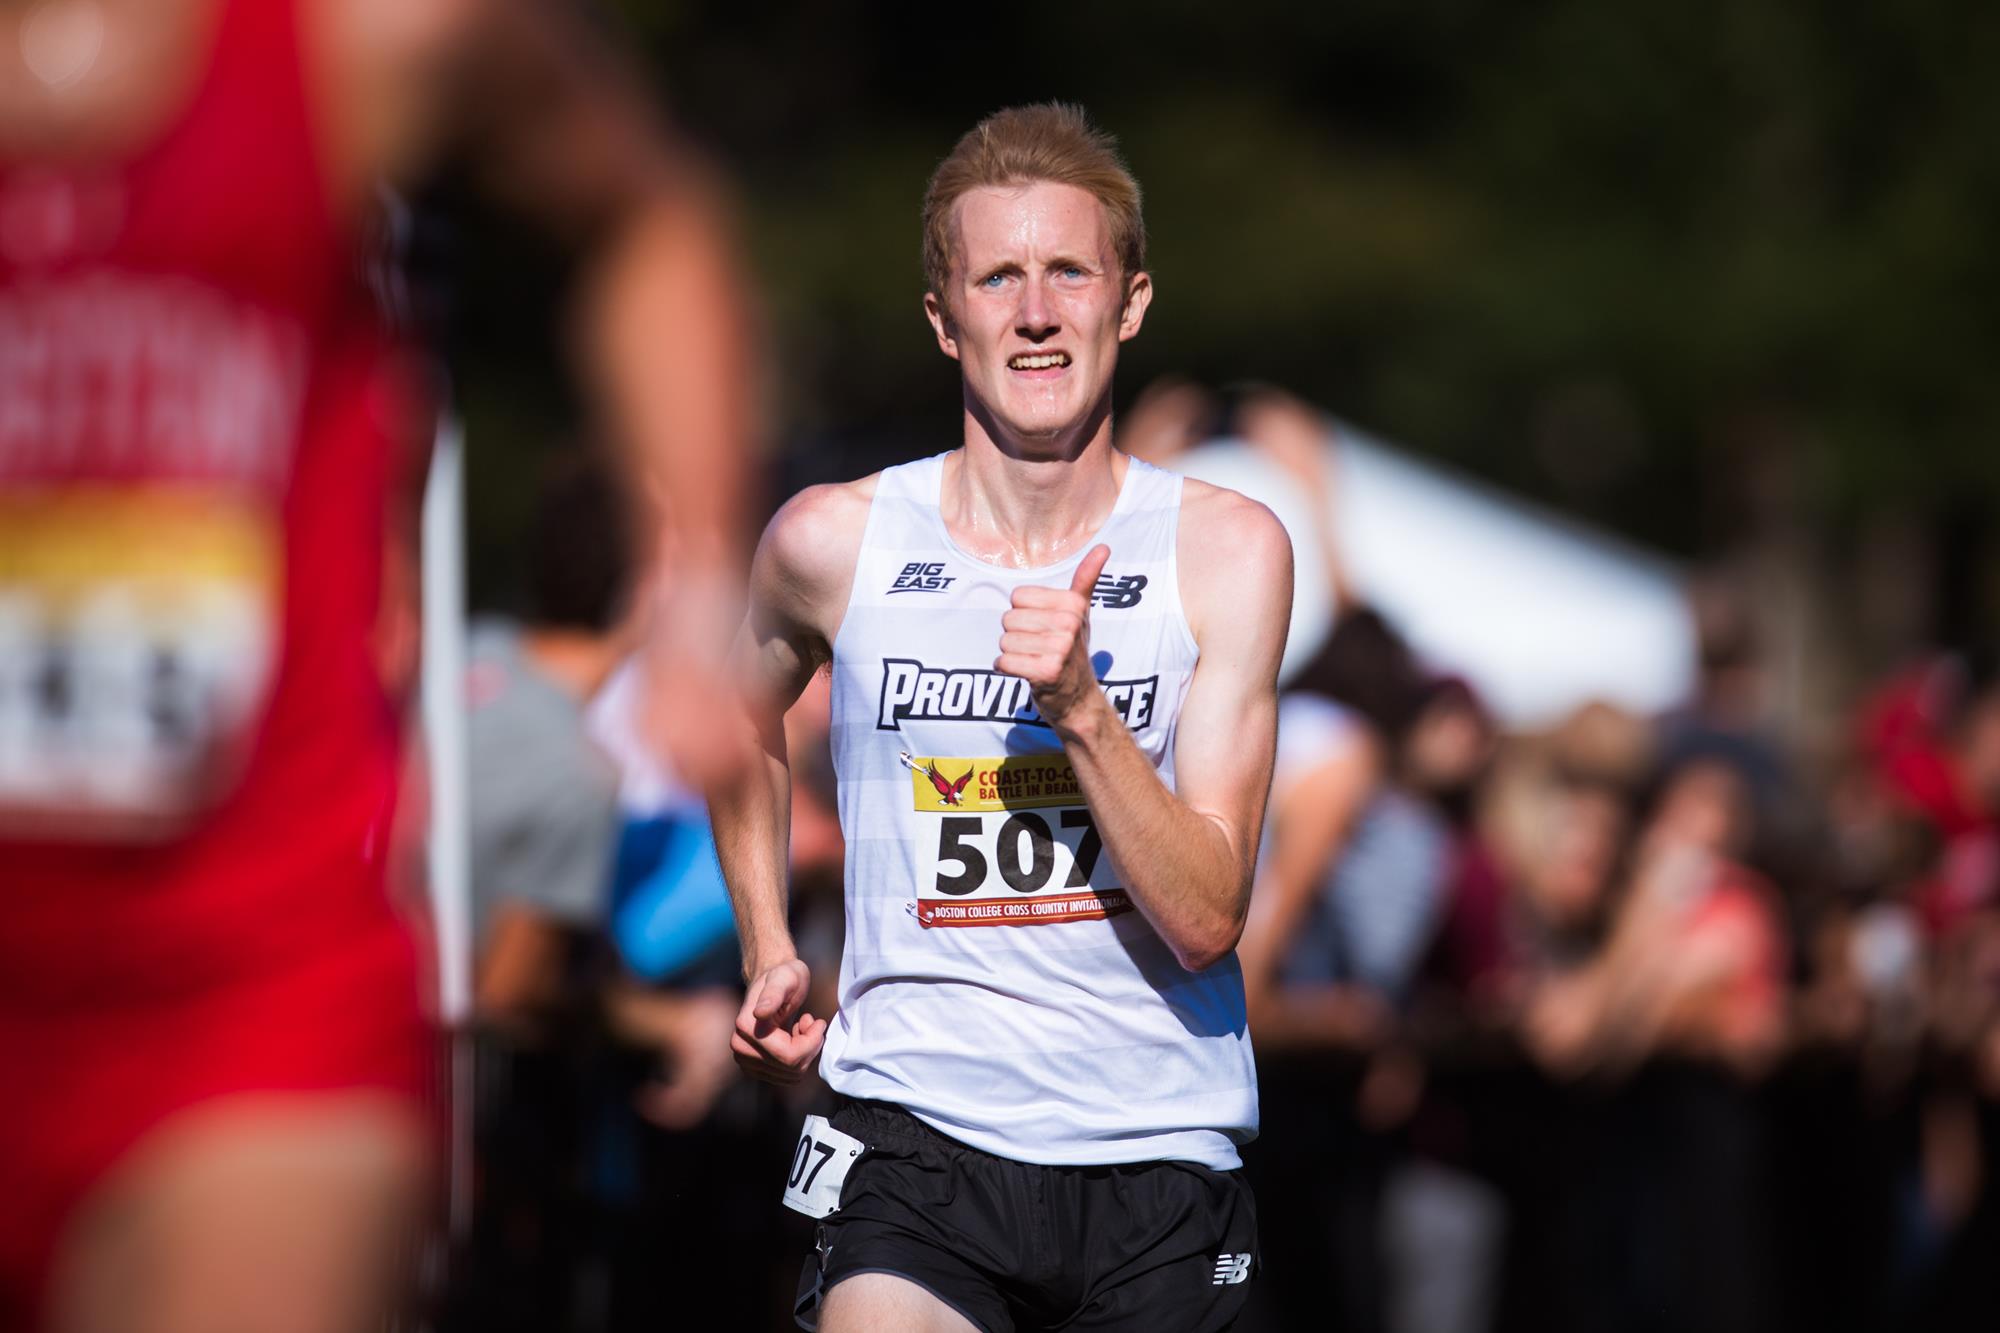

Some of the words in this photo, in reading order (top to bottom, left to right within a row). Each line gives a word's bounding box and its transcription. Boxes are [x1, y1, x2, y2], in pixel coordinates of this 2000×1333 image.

[900, 563, 946, 575] BIG
[892, 576, 957, 589] EAST
[876, 658, 1159, 731] PROVIDCE
[979, 766, 1075, 786] COAST-TO-C
[978, 786, 1023, 799] BATTLE
[1027, 785, 1040, 797] IN
[1045, 782, 1081, 795] BEAN
[935, 811, 1103, 896] 507
[934, 907, 966, 918] BOSTON
[968, 905, 1002, 918] COLLEGE
[1004, 905, 1030, 916] CROSS
[1031, 902, 1068, 915] COUNTRY
[1212, 1252, 1252, 1285] NB
